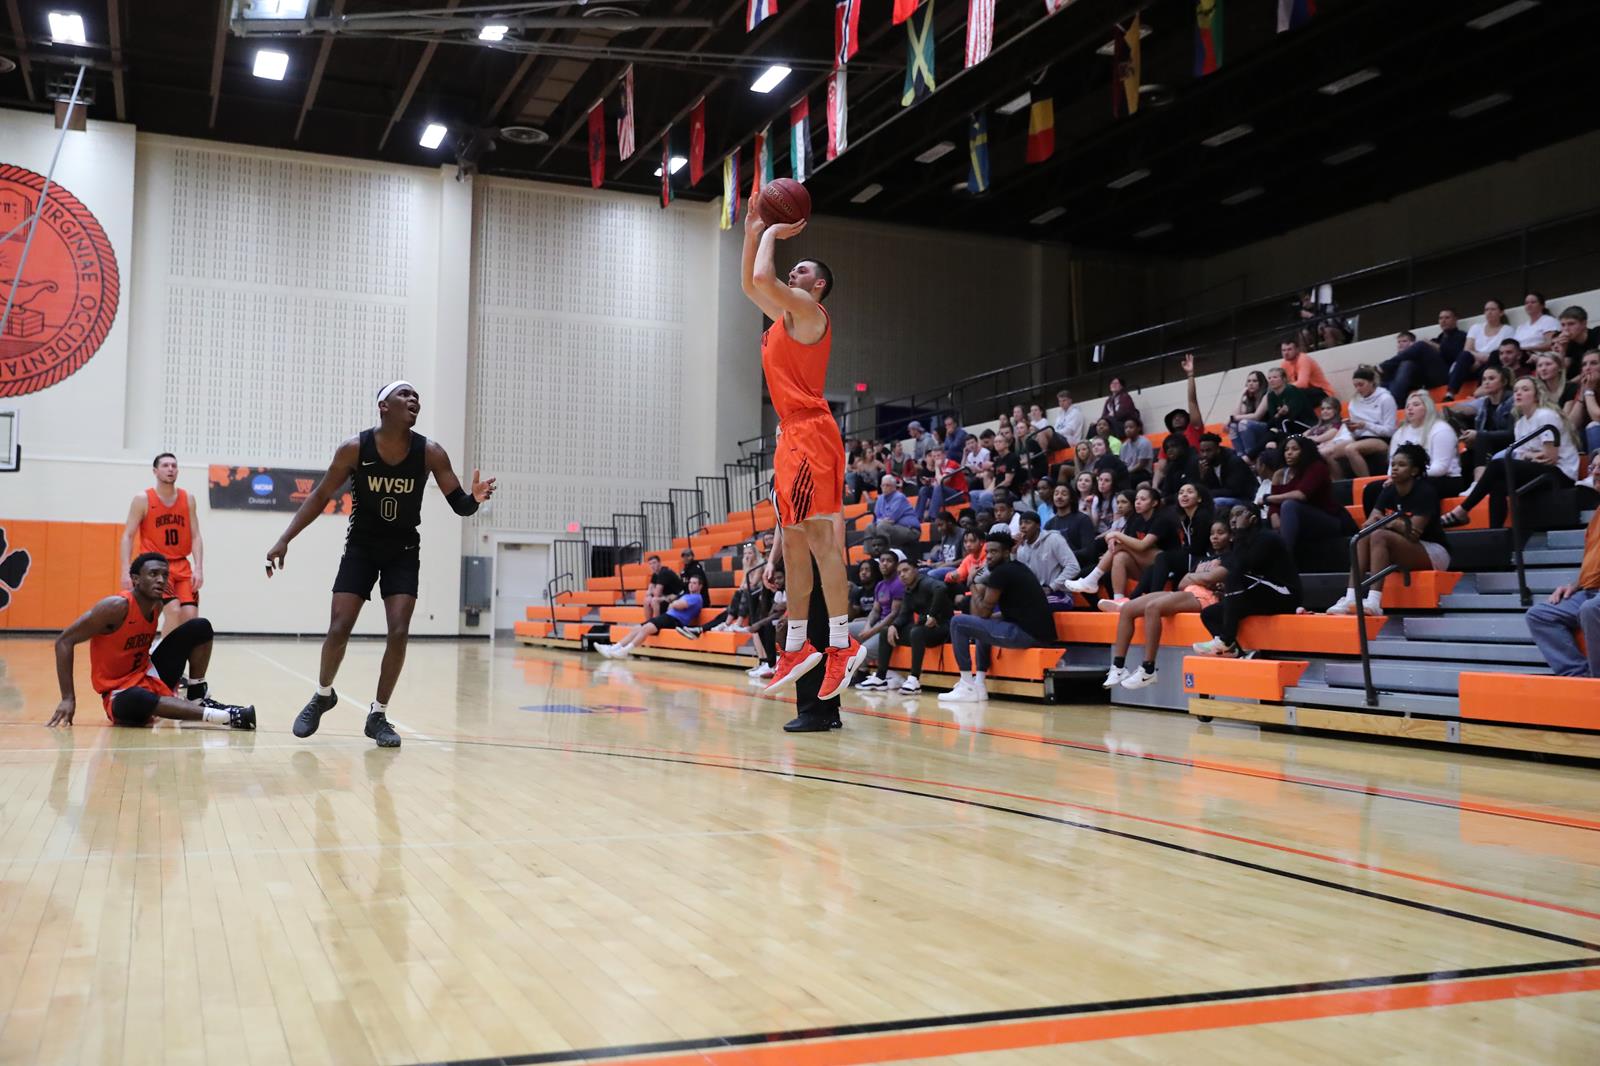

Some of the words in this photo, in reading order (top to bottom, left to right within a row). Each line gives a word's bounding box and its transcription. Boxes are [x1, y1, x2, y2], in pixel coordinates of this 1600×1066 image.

[36, 195, 98, 283] VIRGINIAE
[367, 475, 415, 494] WVSU
[380, 497, 398, 522] 0
[155, 513, 185, 528] BOBCATS
[165, 529, 179, 546] 10
